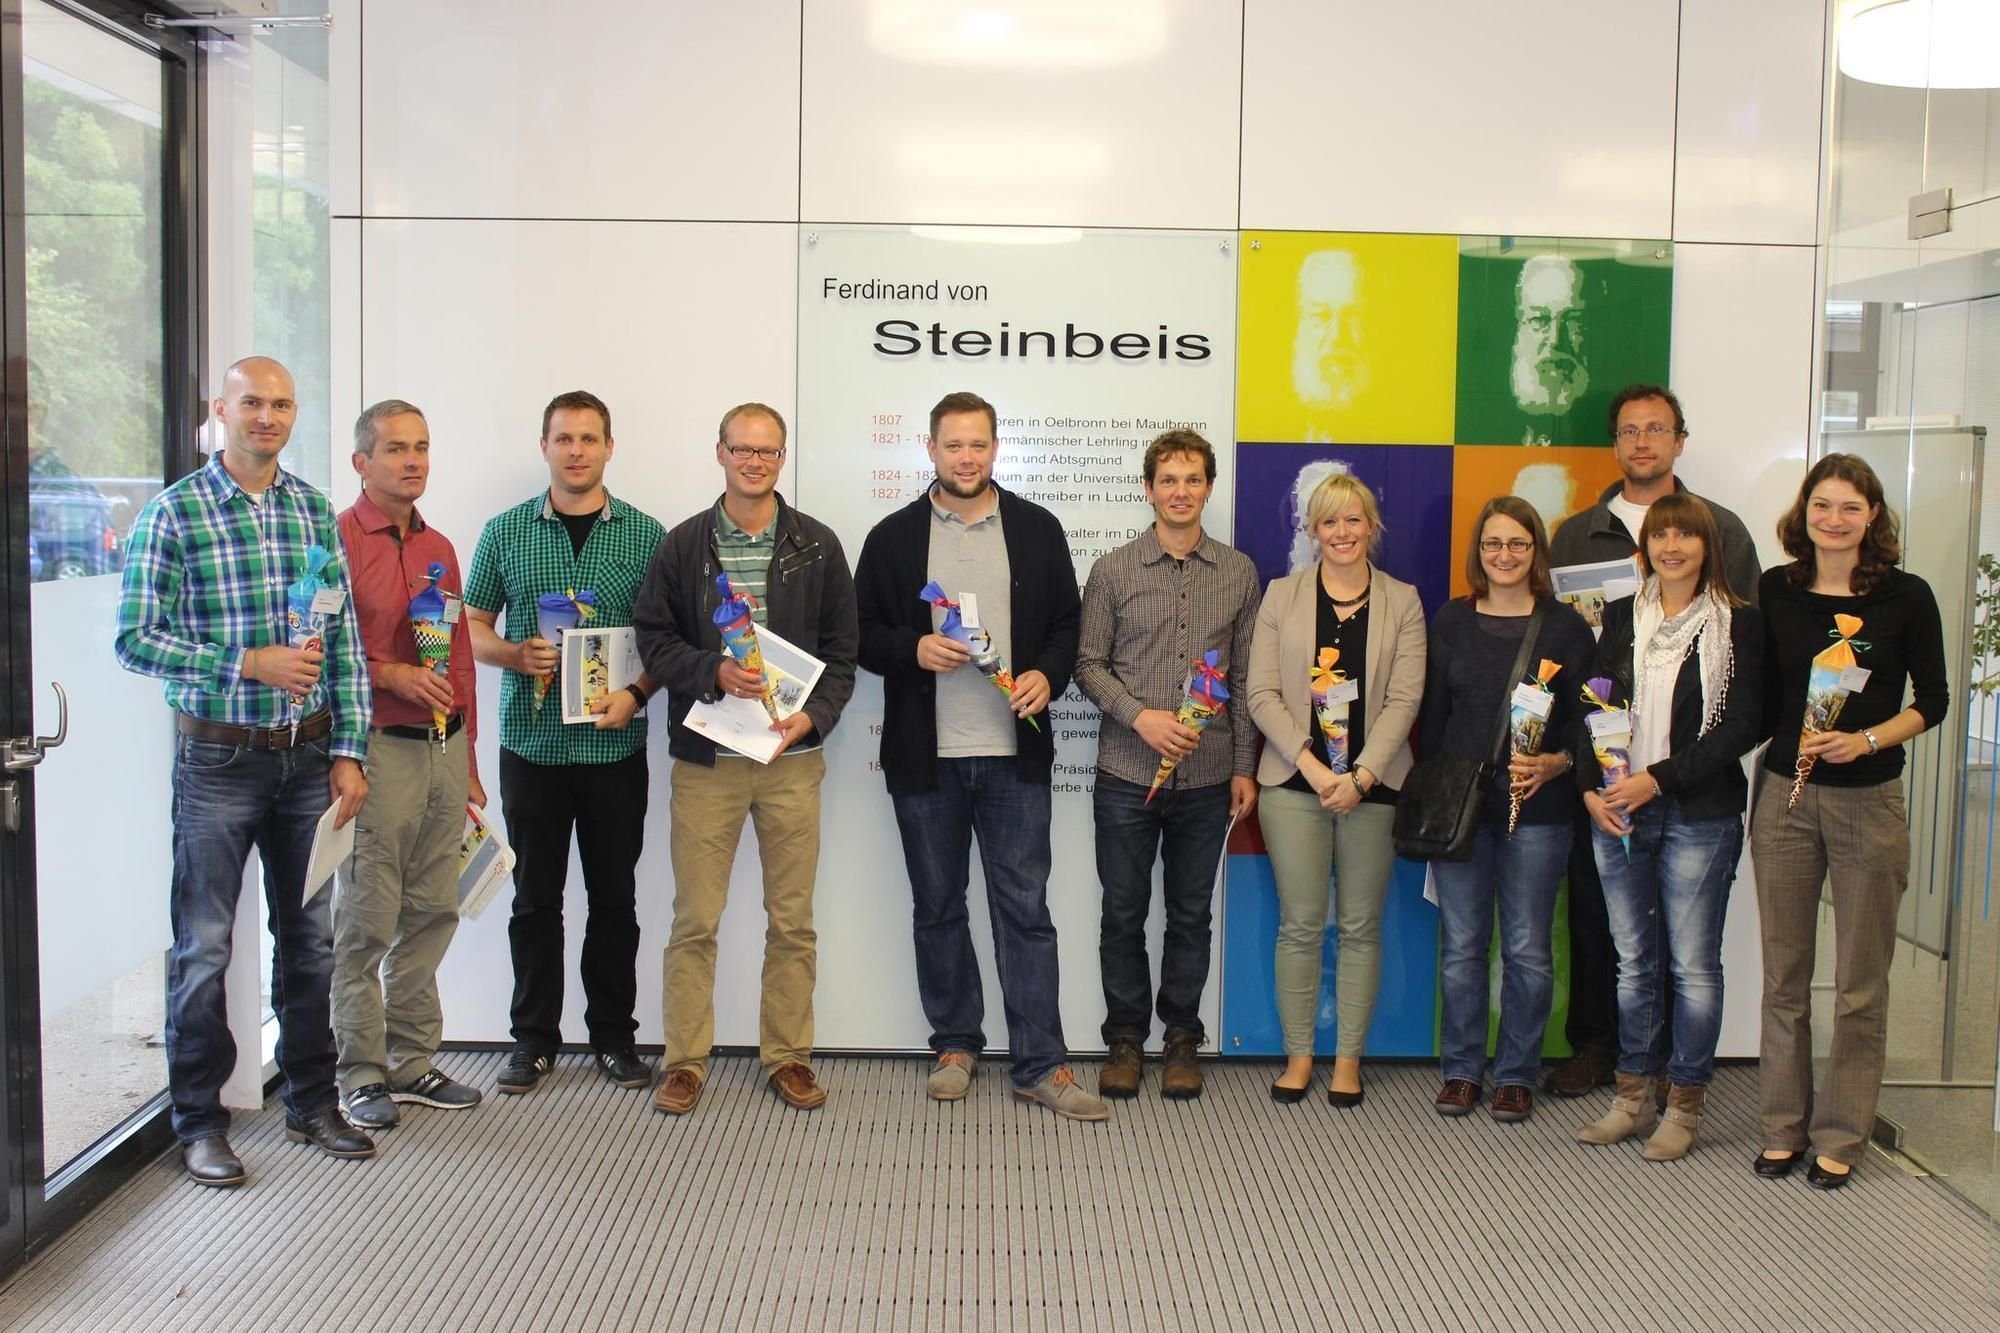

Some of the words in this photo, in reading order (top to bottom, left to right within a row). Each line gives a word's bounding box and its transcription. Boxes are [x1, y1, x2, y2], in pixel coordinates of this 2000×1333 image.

[823, 278, 939, 301] Ferdinand
[947, 282, 988, 301] von
[872, 320, 1211, 360] Steinbeis
[872, 415, 902, 425] 1807
[996, 417, 1024, 427] oren
[1028, 416, 1040, 427] in
[1044, 416, 1107, 428] Oelbronn
[1111, 418, 1131, 429] bei
[1136, 418, 1207, 429] Maulbronn
[872, 433, 901, 444] 1821
[916, 434, 930, 444] 18
[1000, 435, 1083, 446] nmännischer
[1087, 436, 1138, 449] Lehrling
[1022, 453, 1045, 464] und
[1050, 454, 1122, 467] Abtsgmünd
[871, 470, 901, 480] 1824
[915, 471, 938, 480] 182
[1026, 473, 1042, 482] an
[1047, 472, 1069, 483] der
[1073, 472, 1143, 485] Universität
[872, 489, 901, 499] 1827
[1016, 491, 1083, 502] schreiber
[1089, 491, 1100, 502] in
[1106, 492, 1149, 502] Ludwi
[1105, 529, 1121, 539] im
[1070, 548, 1087, 557] on
[1092, 549, 1107, 557] zu
[1050, 710, 1104, 721] Schulwe
[869, 725, 882, 735] 18
[1061, 730, 1101, 741] gewe
[868, 761, 882, 771] 18
[1053, 764, 1097, 775] Präsid
[1052, 783, 1082, 793] erbe
